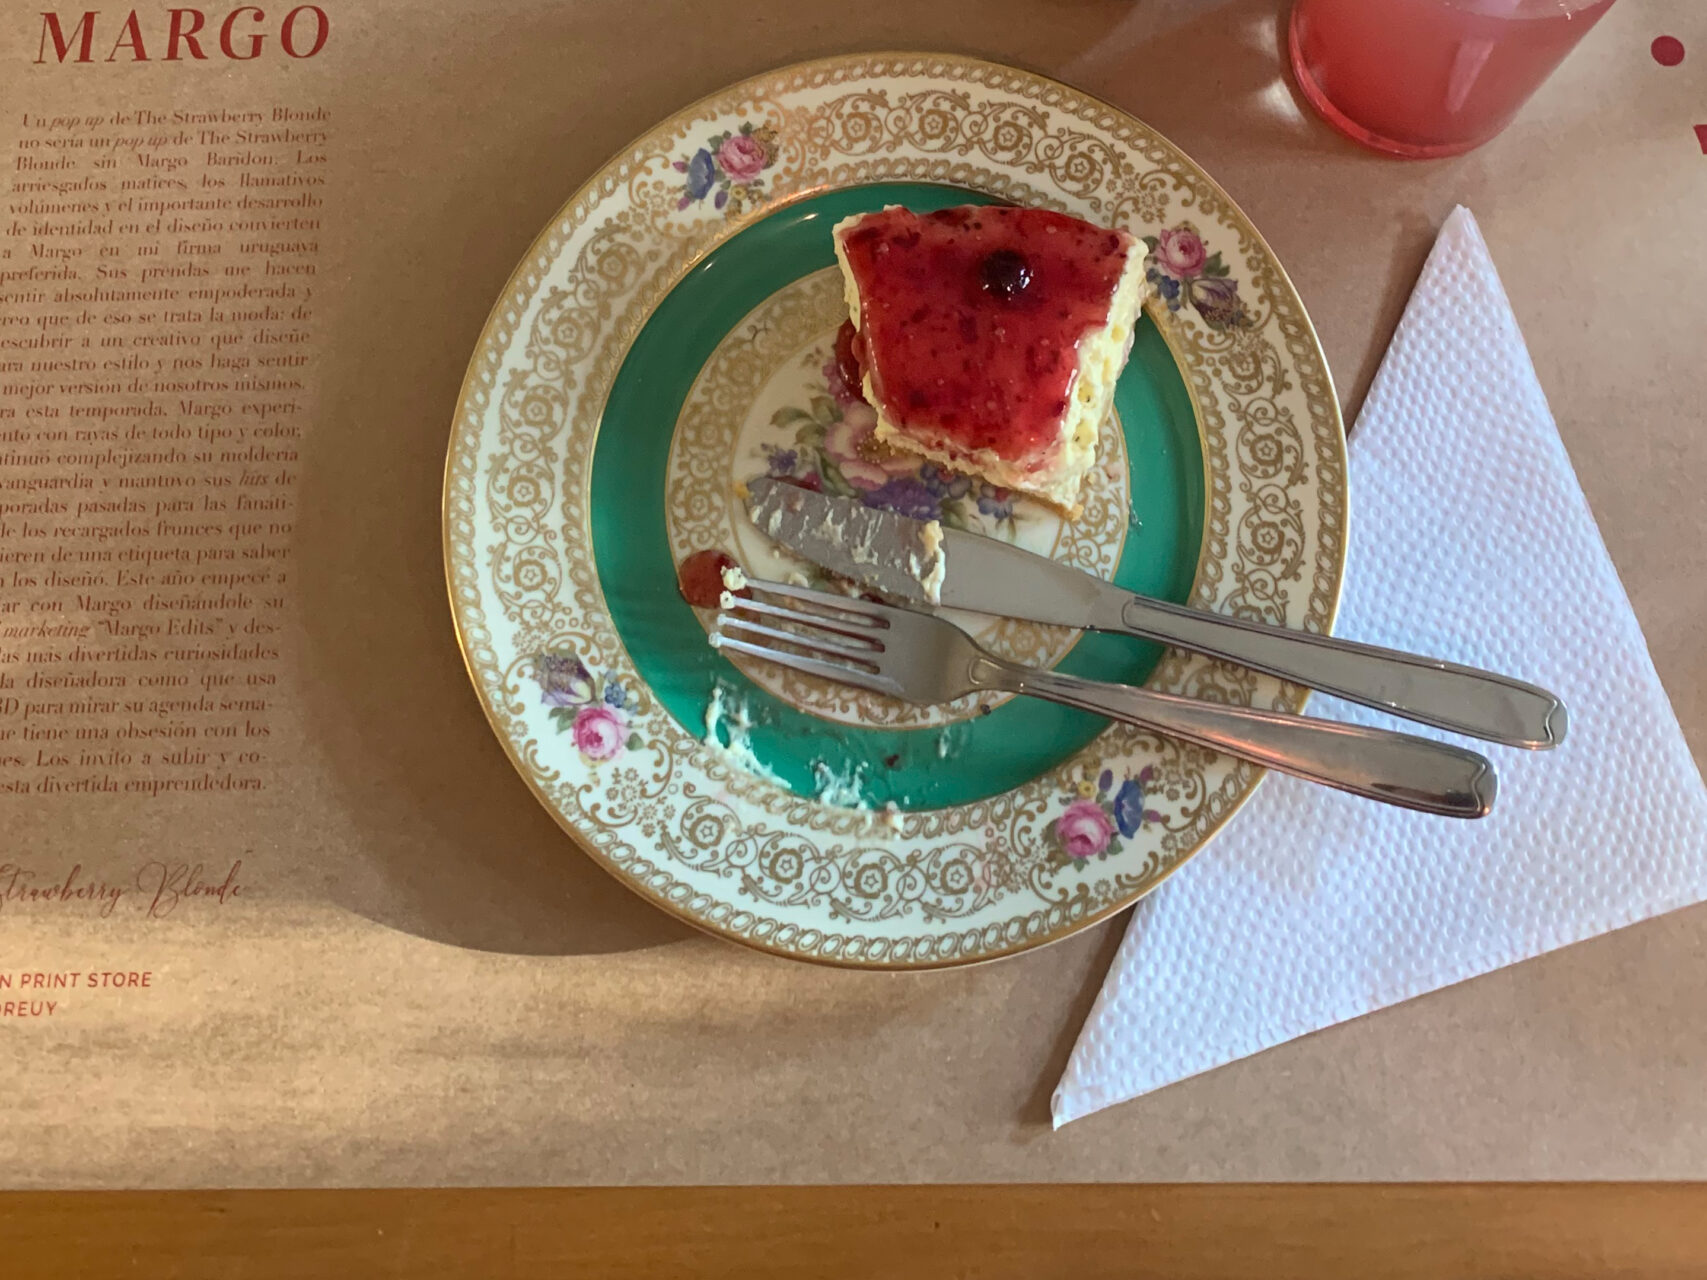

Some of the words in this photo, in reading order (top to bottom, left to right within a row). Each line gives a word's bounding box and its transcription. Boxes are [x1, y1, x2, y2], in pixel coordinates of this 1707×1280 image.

[34, 6, 331, 64] MARGO
[110, 109, 132, 126] de
[134, 109, 167, 126] The
[172, 107, 263, 128] Strawberry
[272, 105, 331, 122] Blonde
[19, 138, 41, 149] no
[89, 136, 111, 148] un
[172, 129, 193, 146] de
[198, 128, 230, 145] The
[235, 126, 328, 148] Strawberry
[15, 154, 77, 171] Blonde
[93, 152, 116, 169] sin
[136, 151, 189, 172] Margo
[296, 148, 327, 165] Los
[10, 174, 107, 196] arriesgados
[200, 172, 226, 189] los
[240, 170, 325, 187] llamativos
[118, 196, 133, 212] el
[138, 194, 232, 216] importante
[237, 192, 323, 210] desarrollo
[6, 219, 27, 236] de
[33, 218, 113, 235] identidad
[118, 223, 139, 234] en
[145, 217, 162, 233] el
[166, 216, 223, 233] diseño
[228, 214, 320, 232] convierten
[30, 241, 83, 263] Margo
[98, 246, 120, 257] en
[138, 240, 160, 257] mi
[177, 239, 221, 256] firma
[96, 263, 127, 280] Sus
[141, 261, 210, 283] prendas
[265, 259, 316, 277] hacen
[53, 284, 180, 303] absolutamente
[188, 282, 295, 304] empoderada
[37, 314, 70, 330] que
[75, 308, 97, 325] de
[103, 313, 132, 324] eso
[137, 312, 156, 324] se
[164, 309, 202, 323] trata
[209, 306, 224, 322] la
[291, 304, 312, 321] de
[100, 336, 124, 348] un
[131, 329, 201, 347] creativo
[211, 334, 243, 349] que
[253, 327, 310, 345] diseñe
[31, 357, 96, 371] nuestro
[103, 353, 149, 370] estilo
[173, 358, 203, 369] nos
[210, 351, 250, 372] haga
[2, 379, 54, 400] mejor
[127, 377, 148, 394] de
[154, 379, 229, 393] nosotros
[26, 405, 59, 419] esta
[178, 399, 233, 420] Margo
[36, 431, 68, 443] con
[125, 424, 147, 441] de
[152, 423, 191, 440] todo
[198, 423, 233, 444] tipo
[193, 452, 212, 463] su
[118, 474, 196, 489] mantuvo
[202, 476, 232, 488] sus
[275, 470, 296, 487] de
[77, 496, 148, 518] pasadas
[155, 501, 194, 517] para
[204, 495, 227, 512] las
[22, 522, 47, 539] los
[53, 520, 150, 542] recargados
[157, 519, 223, 537] frunces
[228, 524, 264, 540] que
[269, 524, 292, 535] no
[51, 546, 73, 563] de
[78, 551, 112, 563] una
[118, 545, 190, 566] etiqueta
[196, 550, 235, 565] para
[242, 543, 291, 560] saber
[12, 571, 37, 588] los
[117, 570, 155, 587] Este
[160, 569, 195, 586] año
[29, 601, 63, 613] con
[76, 595, 132, 616] Margo
[264, 598, 283, 610] su
[2, 620, 91, 642] marketing
[26, 646, 62, 663] más
[68, 645, 157, 663] divertidas
[163, 644, 279, 662] curiosidades
[26, 671, 126, 689] diseñadora
[138, 676, 189, 688] como
[200, 675, 235, 691] que
[246, 675, 276, 686] usa
[23, 703, 64, 718] para
[68, 697, 119, 714] mirar
[123, 702, 144, 713] su
[149, 696, 214, 717] agenda
[23, 724, 69, 741] tiene
[75, 729, 109, 741] una
[115, 723, 197, 740] obsesión
[204, 728, 237, 739] con
[245, 722, 271, 739] los
[36, 750, 70, 767] Los
[80, 749, 132, 767] invito
[161, 749, 210, 766] subir
[36, 776, 119, 793] divertida
[124, 774, 266, 796] emprendedora.
[136, 861, 246, 919] Blonde
[20, 972, 80, 989] PRINT
[87, 972, 153, 988] STORE
[0, 1001, 57, 1018] REUY
